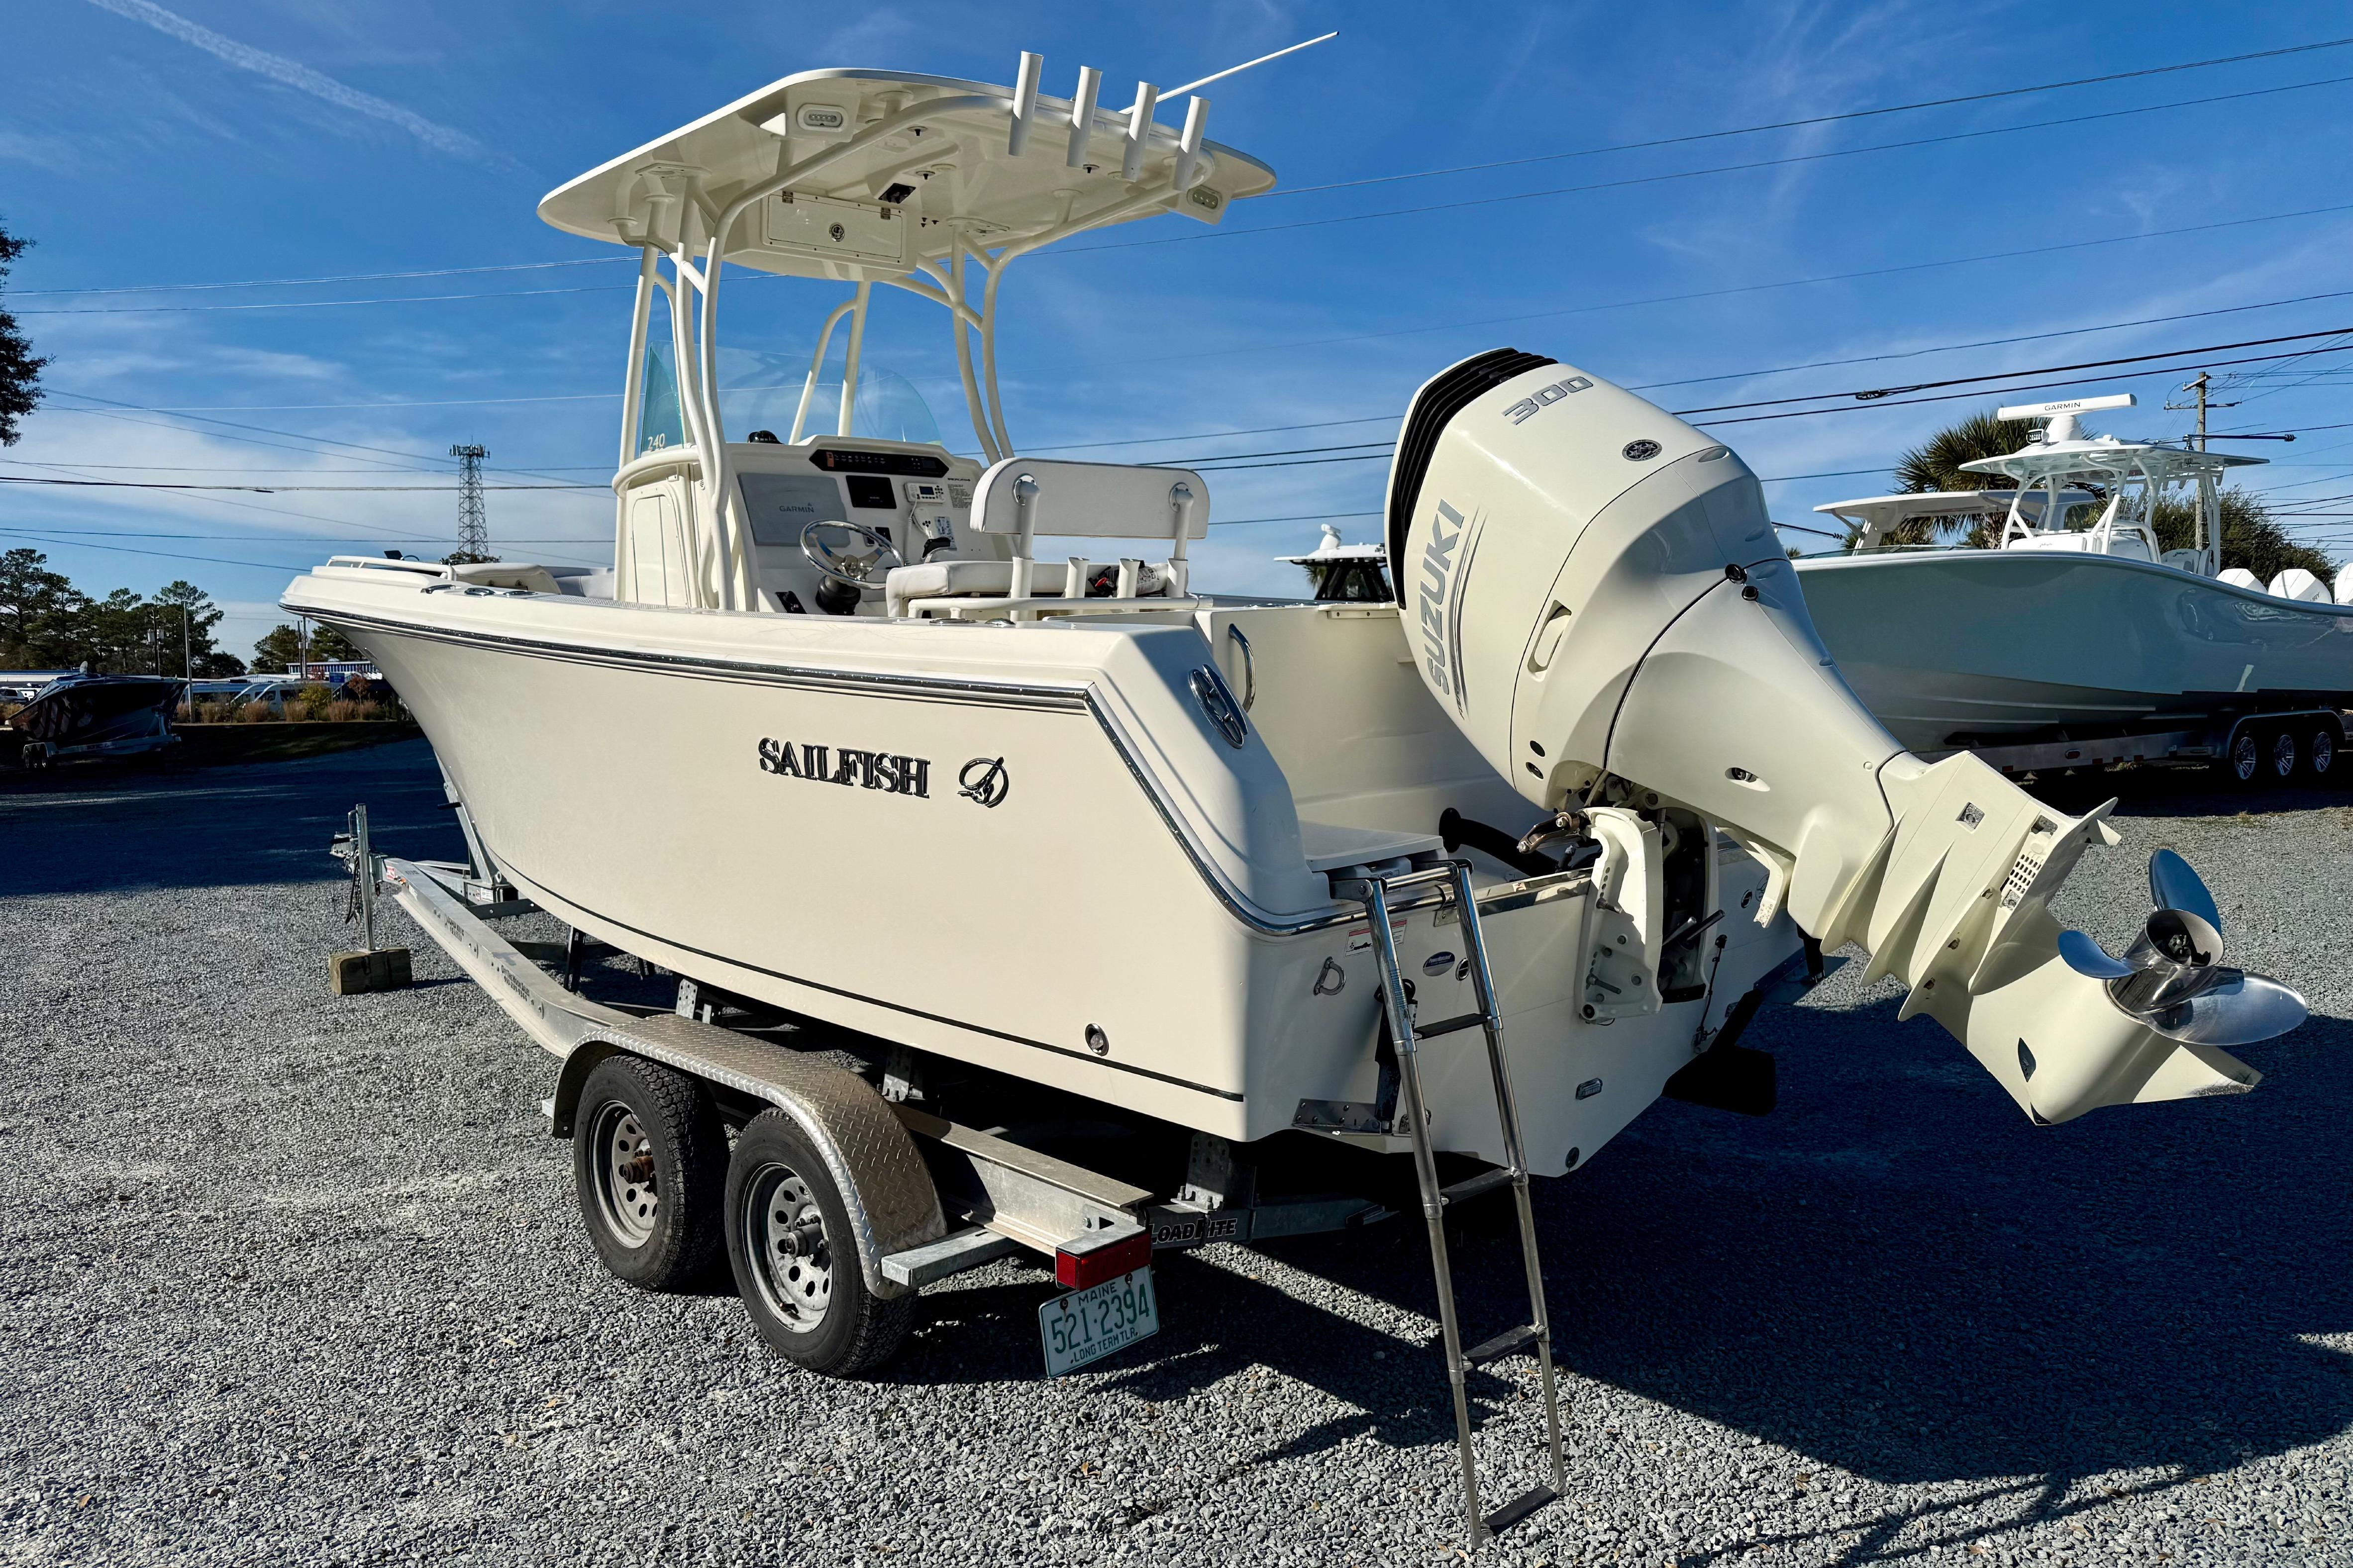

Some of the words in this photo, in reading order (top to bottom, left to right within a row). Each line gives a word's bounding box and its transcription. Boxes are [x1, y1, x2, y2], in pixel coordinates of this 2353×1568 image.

[1501, 376, 1594, 425] 300
[2045, 401, 2081, 411] GARMIN
[648, 433, 665, 450] 240
[779, 504, 815, 513] GARMIN
[1420, 497, 1465, 695] SUZUKI
[758, 737, 931, 799] SAILFISH
[1078, 1281, 1117, 1306] MAINE
[1096, 1336, 1120, 1352] TERM
